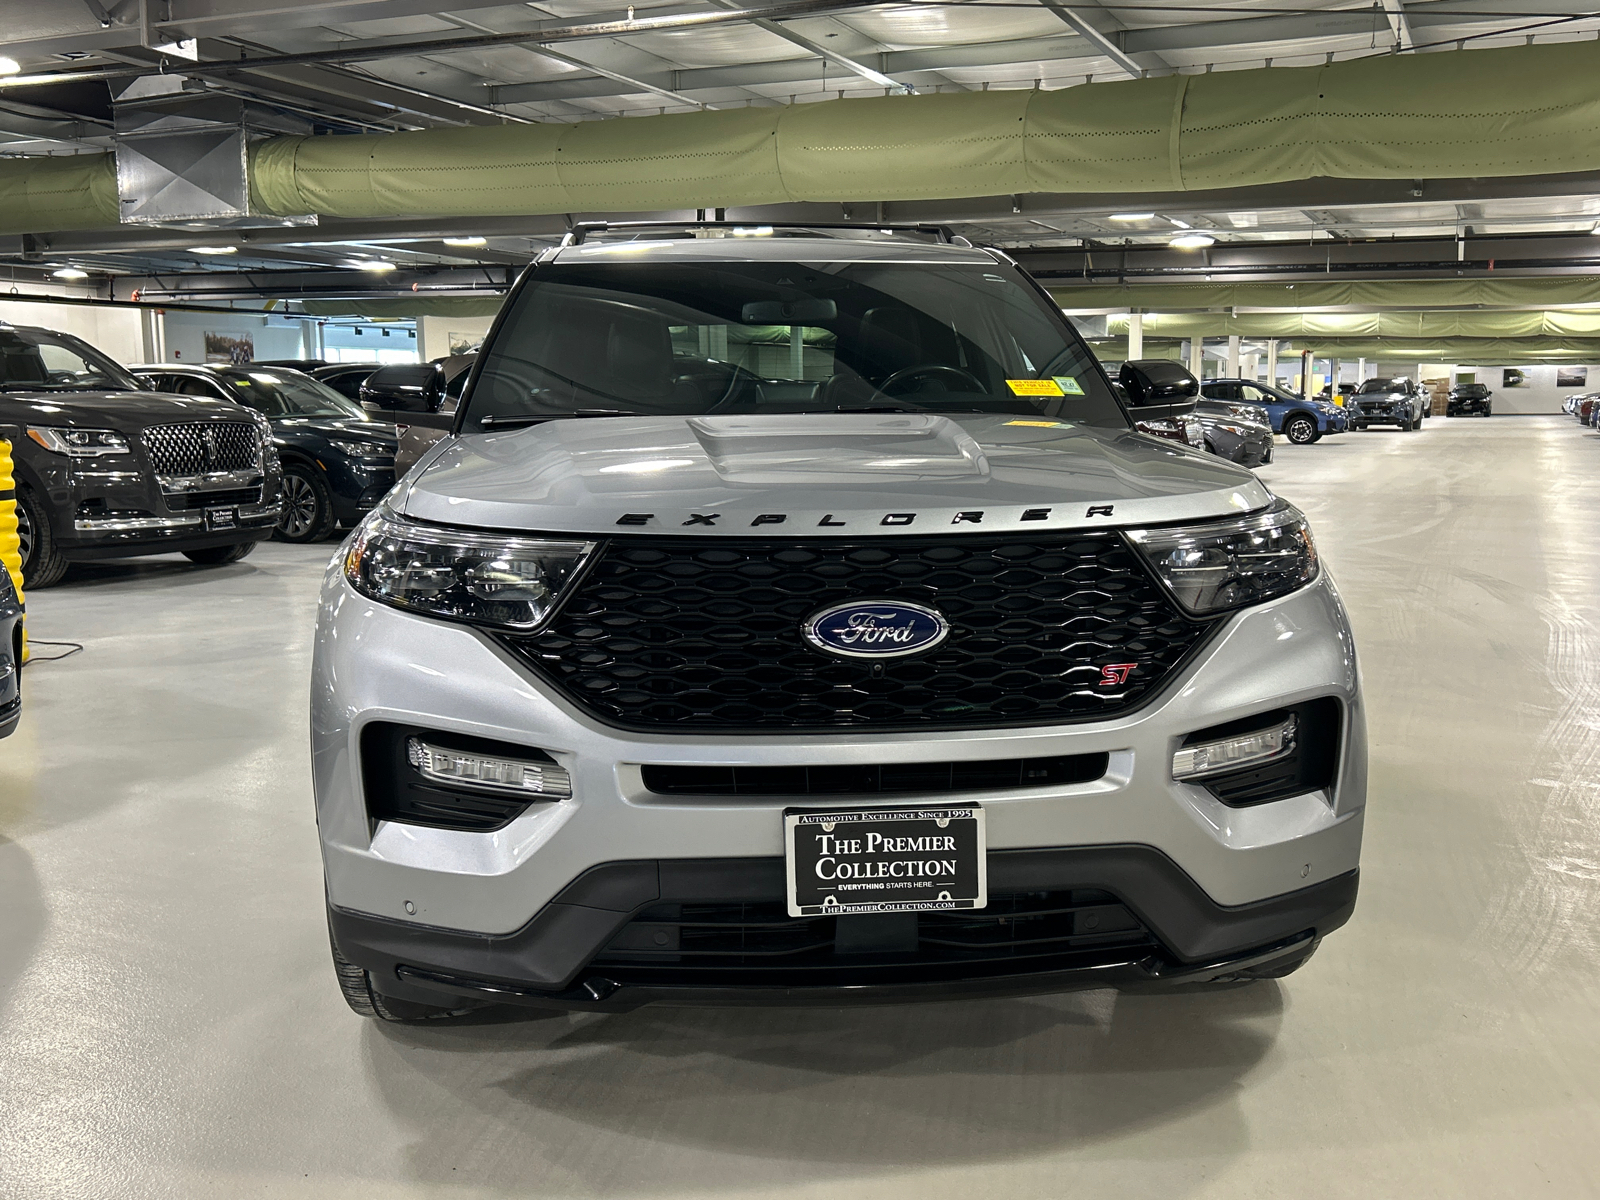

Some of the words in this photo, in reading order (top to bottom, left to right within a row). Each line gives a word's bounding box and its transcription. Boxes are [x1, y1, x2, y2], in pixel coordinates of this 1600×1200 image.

[615, 505, 1114, 526] EXPLORER
[831, 612, 916, 644] Ford
[1099, 663, 1138, 686] ST
[801, 814, 859, 823] AUTOMOTIVE
[862, 812, 915, 820] EXCELLENCE
[947, 810, 971, 818] 1995
[815, 834, 861, 855] THE
[865, 832, 957, 853] PREMIER
[815, 857, 957, 880] COLLECTION
[838, 882, 885, 891] EVERYTHING
